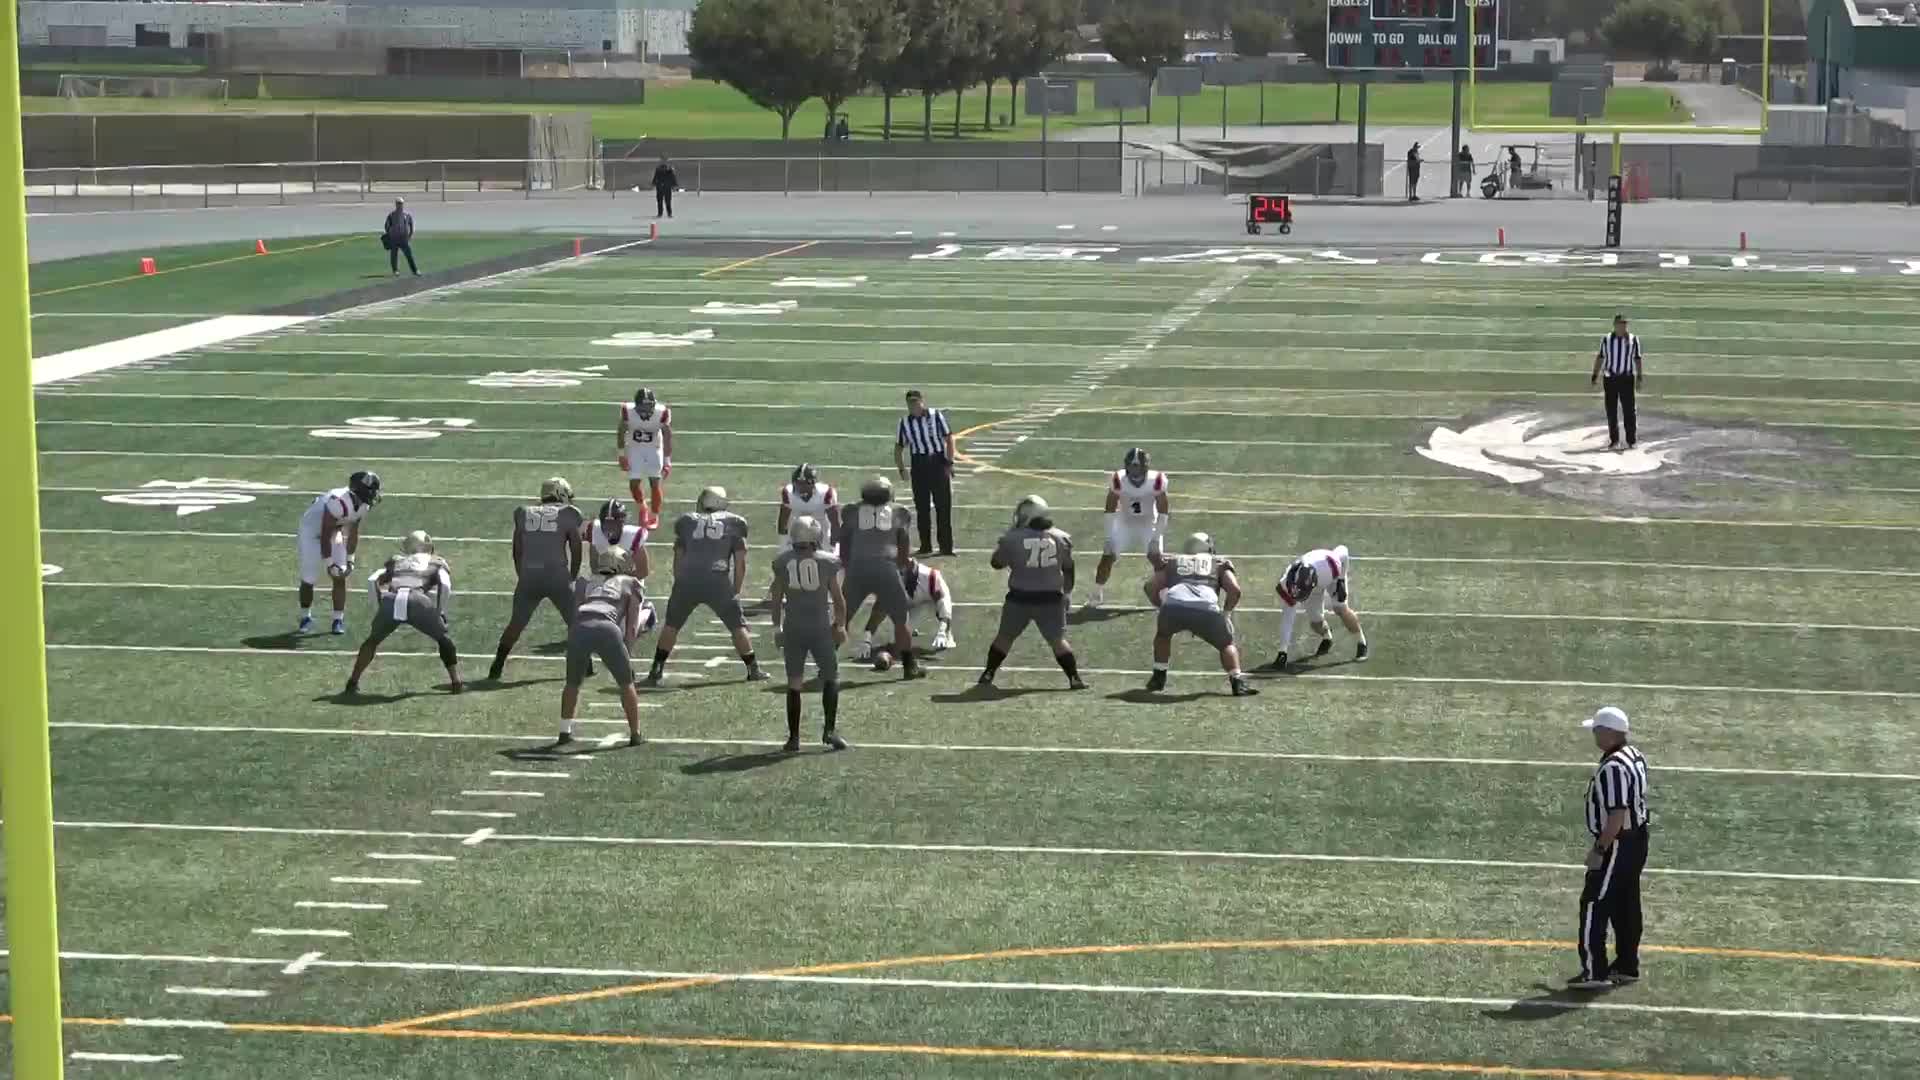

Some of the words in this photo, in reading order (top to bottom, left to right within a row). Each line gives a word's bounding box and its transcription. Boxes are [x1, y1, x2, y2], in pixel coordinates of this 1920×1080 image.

[1330, 32, 1361, 44] DOWN
[1373, 33, 1386, 44] TO
[1389, 33, 1405, 44] GO
[1418, 34, 1441, 45] BALL
[1443, 34, 1457, 45] ON
[1254, 197, 1285, 220] 24
[525, 505, 559, 532] 52
[1023, 538, 1058, 568] 72
[787, 558, 821, 591] 10
